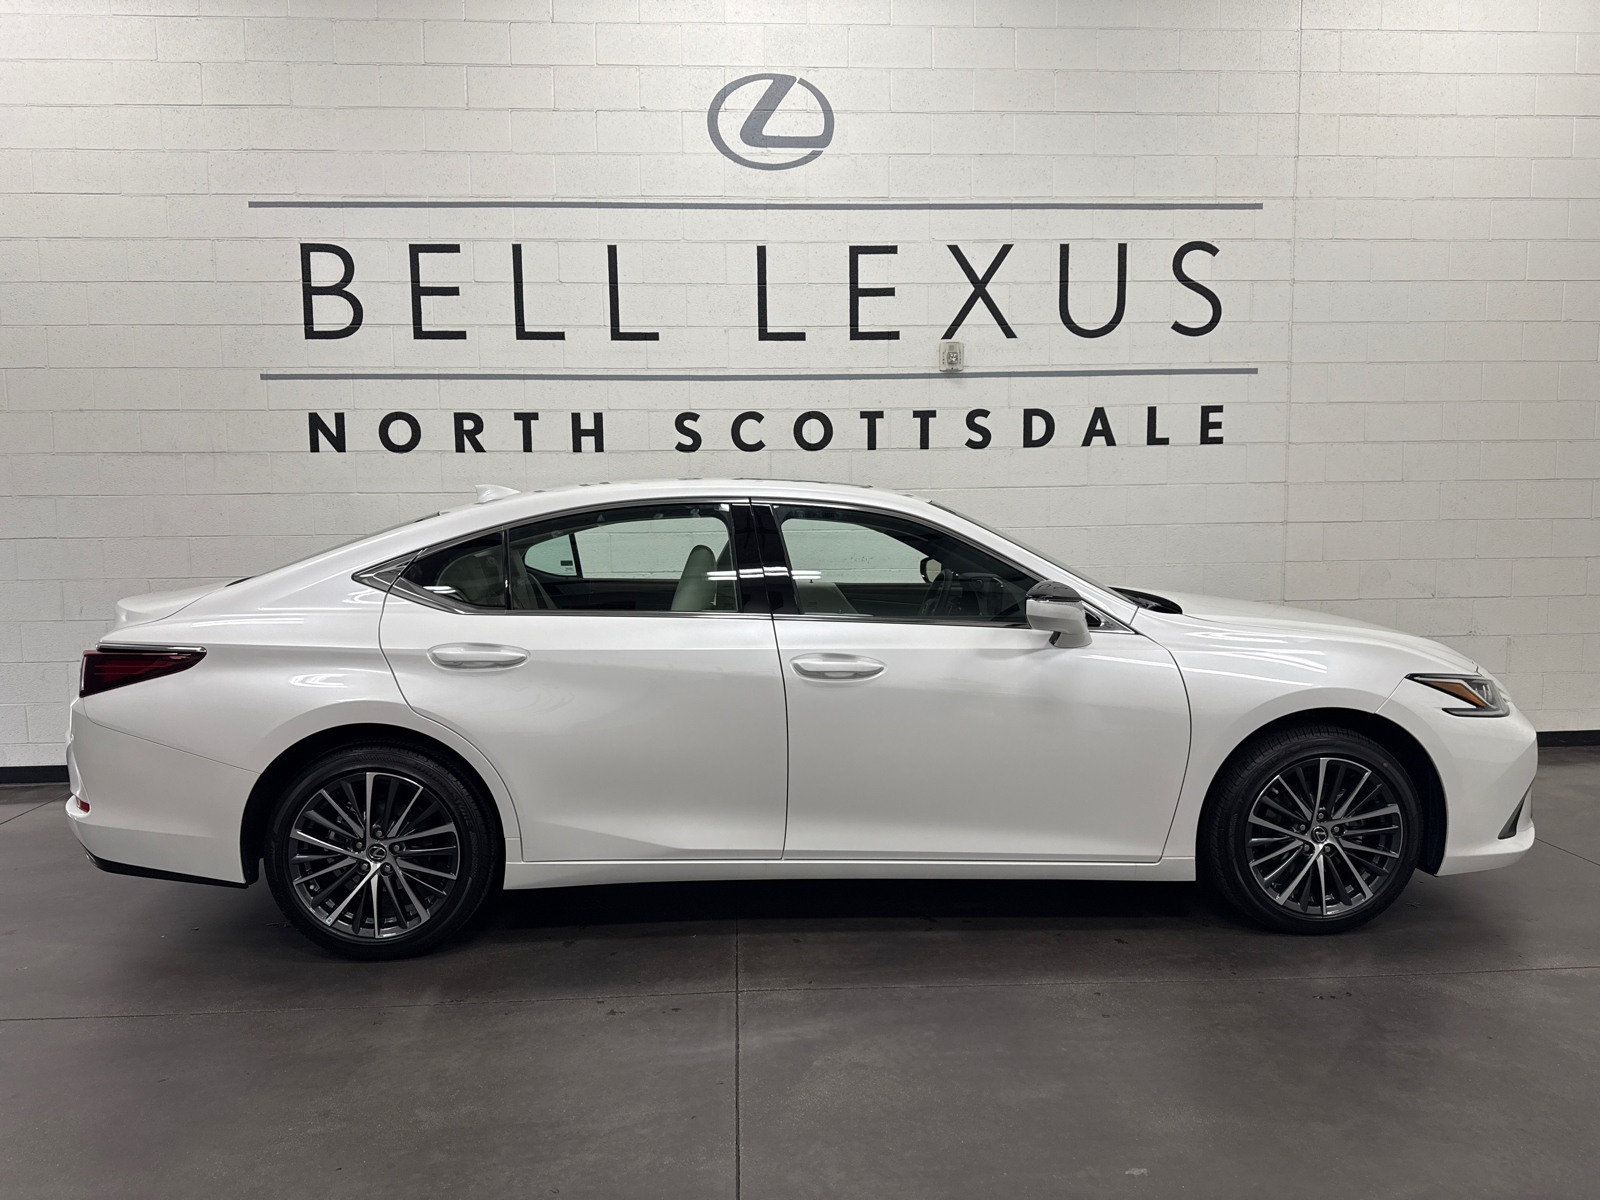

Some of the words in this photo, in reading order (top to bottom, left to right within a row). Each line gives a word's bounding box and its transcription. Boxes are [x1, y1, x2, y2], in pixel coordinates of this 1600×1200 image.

[299, 242, 660, 342] BELL
[756, 240, 1222, 342] LEXUS
[308, 411, 605, 454] NORTH
[674, 404, 1224, 454] SCOTTSDALE
